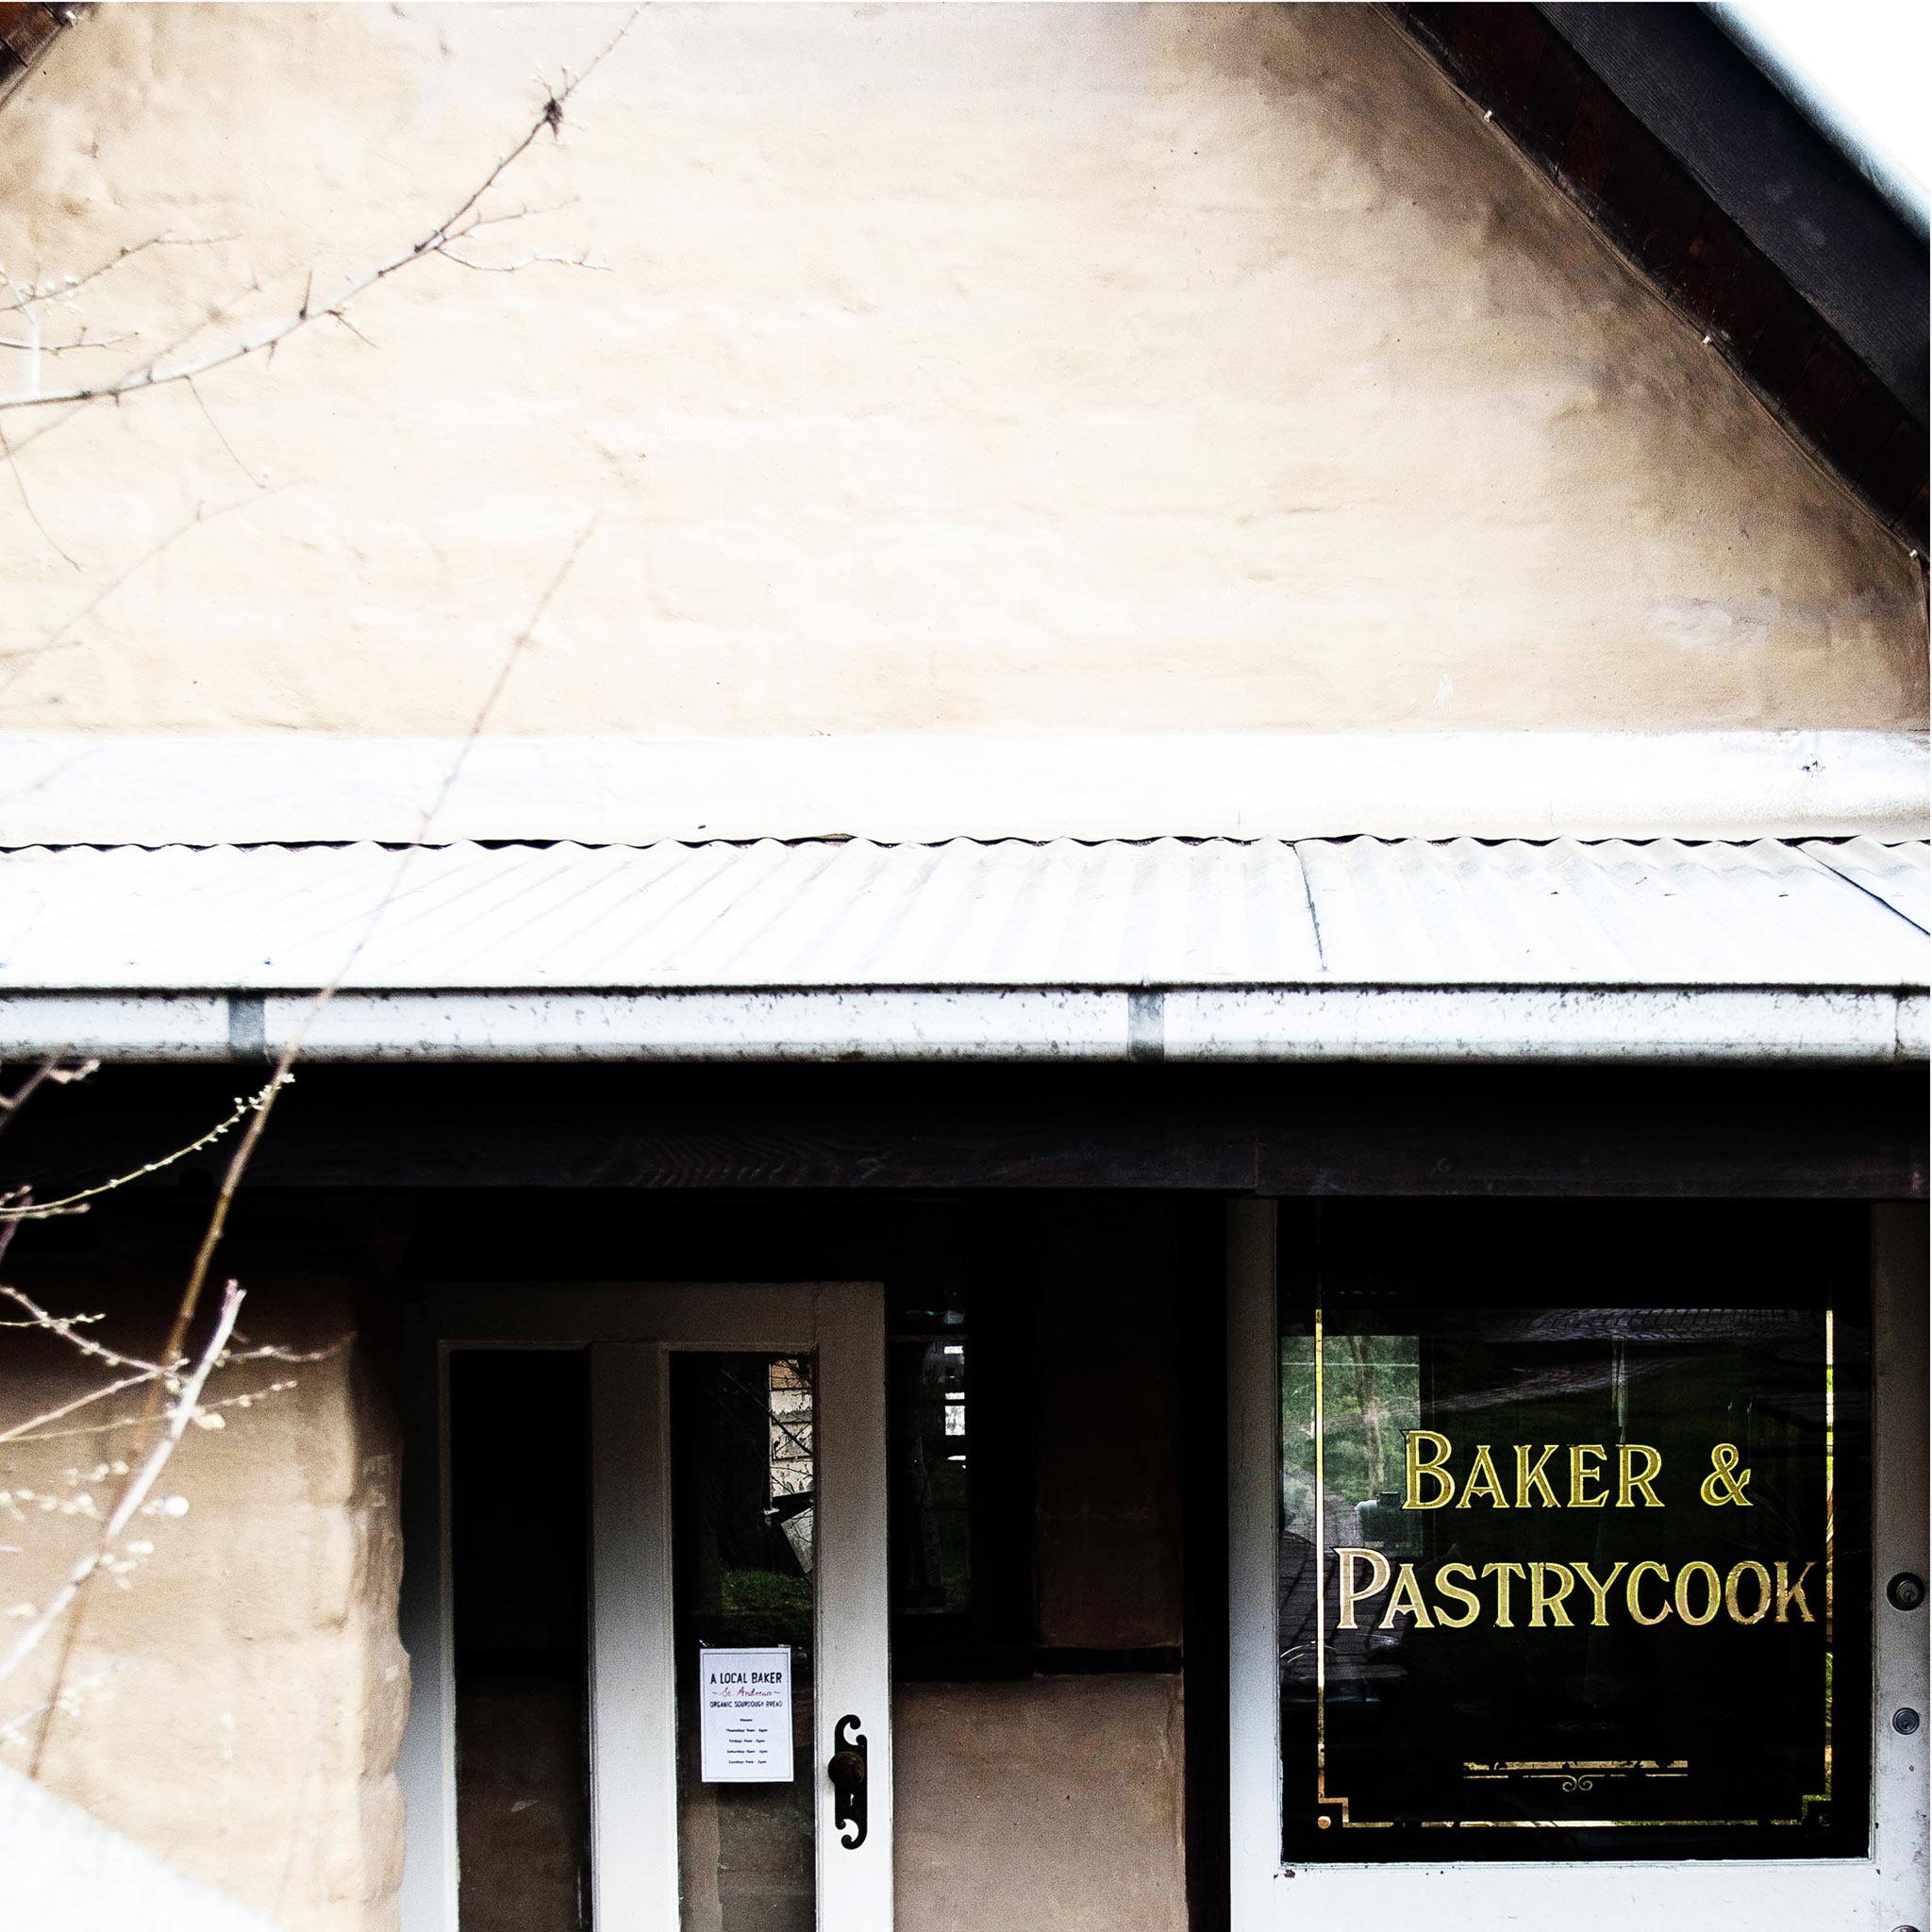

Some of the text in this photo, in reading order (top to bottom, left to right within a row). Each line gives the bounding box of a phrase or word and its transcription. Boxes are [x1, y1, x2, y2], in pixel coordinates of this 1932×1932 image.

[1401, 1429, 1754, 1508] BAKER &
[1333, 1546, 1817, 1629] PASTRYCOOK
[710, 1672, 783, 1684] A LOCAL BAKER
